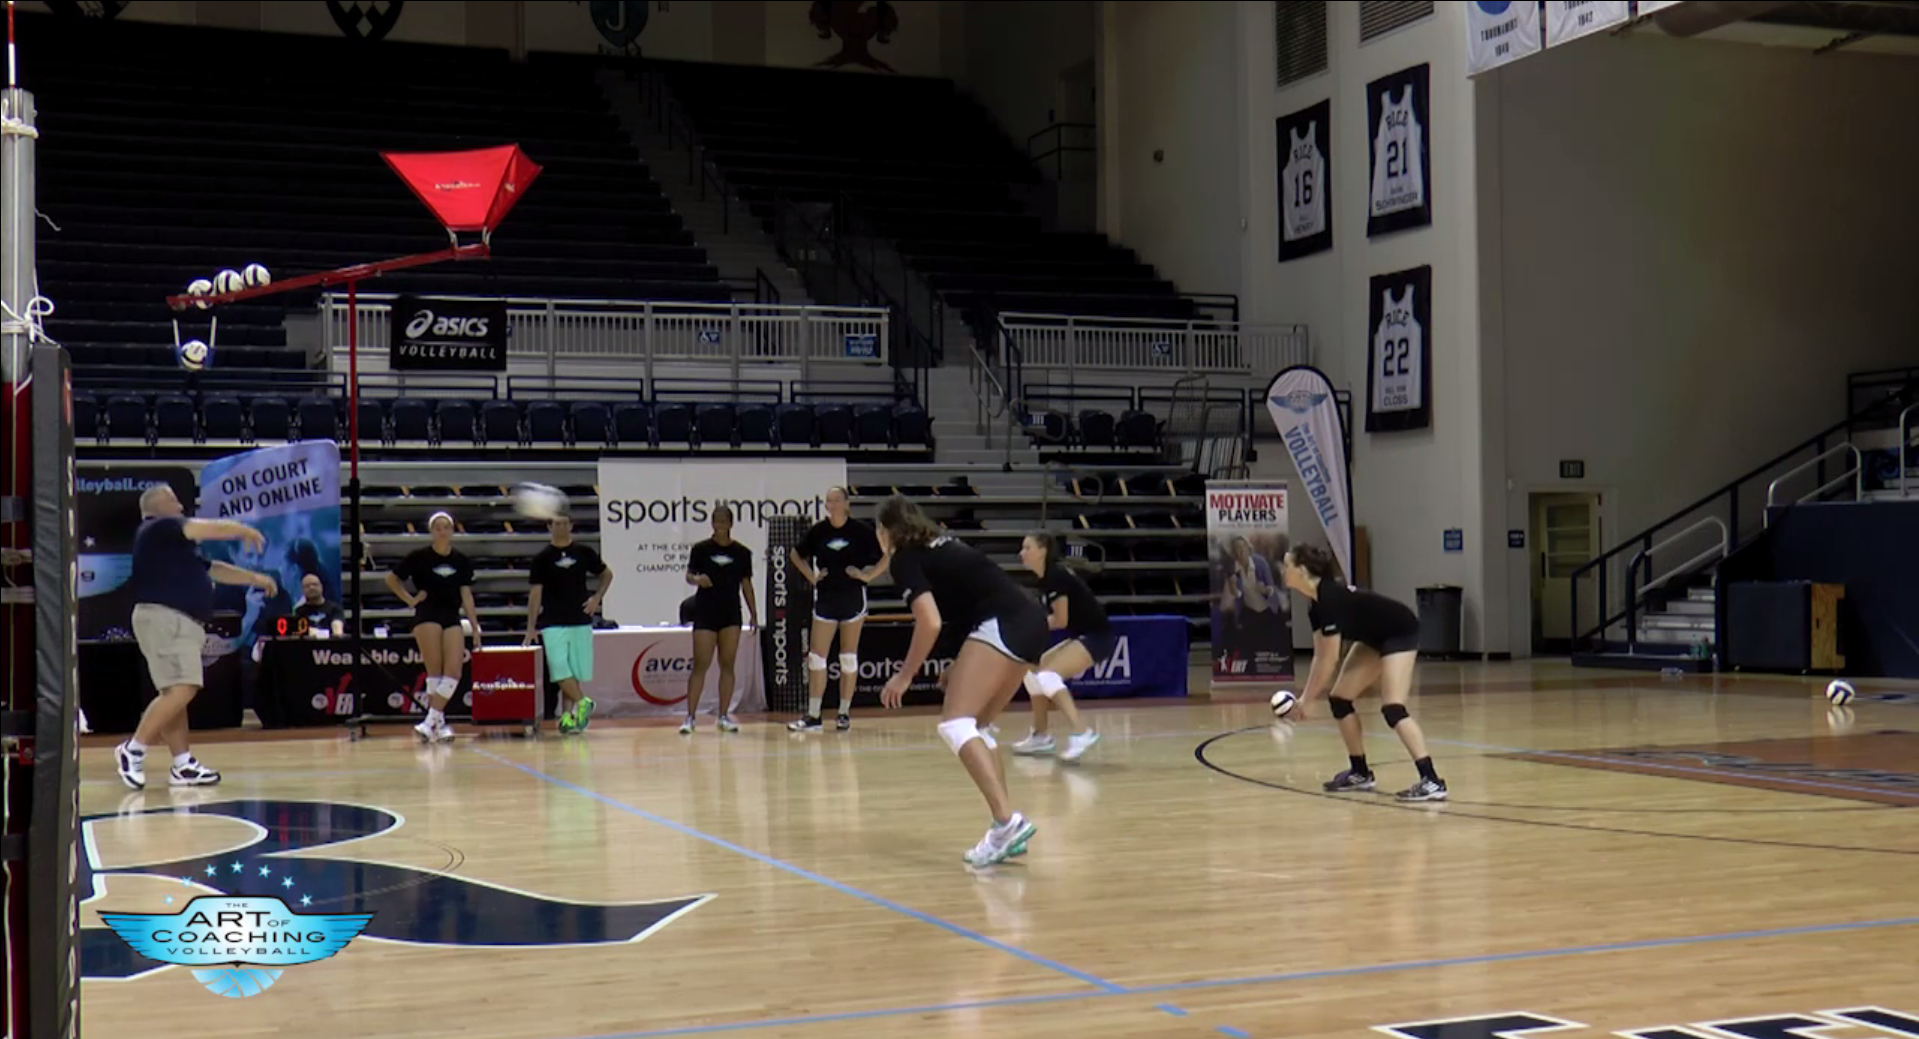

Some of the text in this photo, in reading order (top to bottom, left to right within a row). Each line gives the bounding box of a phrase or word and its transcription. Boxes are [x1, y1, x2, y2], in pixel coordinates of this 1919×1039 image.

[1385, 110, 1409, 131] RICE
[1386, 137, 1408, 179] 21
[1294, 169, 1313, 208] 16
[432, 316, 490, 338] asics
[1385, 308, 1409, 329] RICE
[398, 345, 497, 359] VOLLEYBALL
[1383, 337, 1409, 377] 22
[222, 458, 308, 495] ON COURT
[1284, 425, 1339, 527] VOLLEYBALL
[220, 477, 322, 518] AND ONLINE
[607, 496, 708, 529] sports
[1210, 493, 1285, 509] MOTIVATE
[1218, 510, 1277, 522] PLAYERS
[772, 545, 788, 607] sports
[312, 648, 399, 665] Weaable
